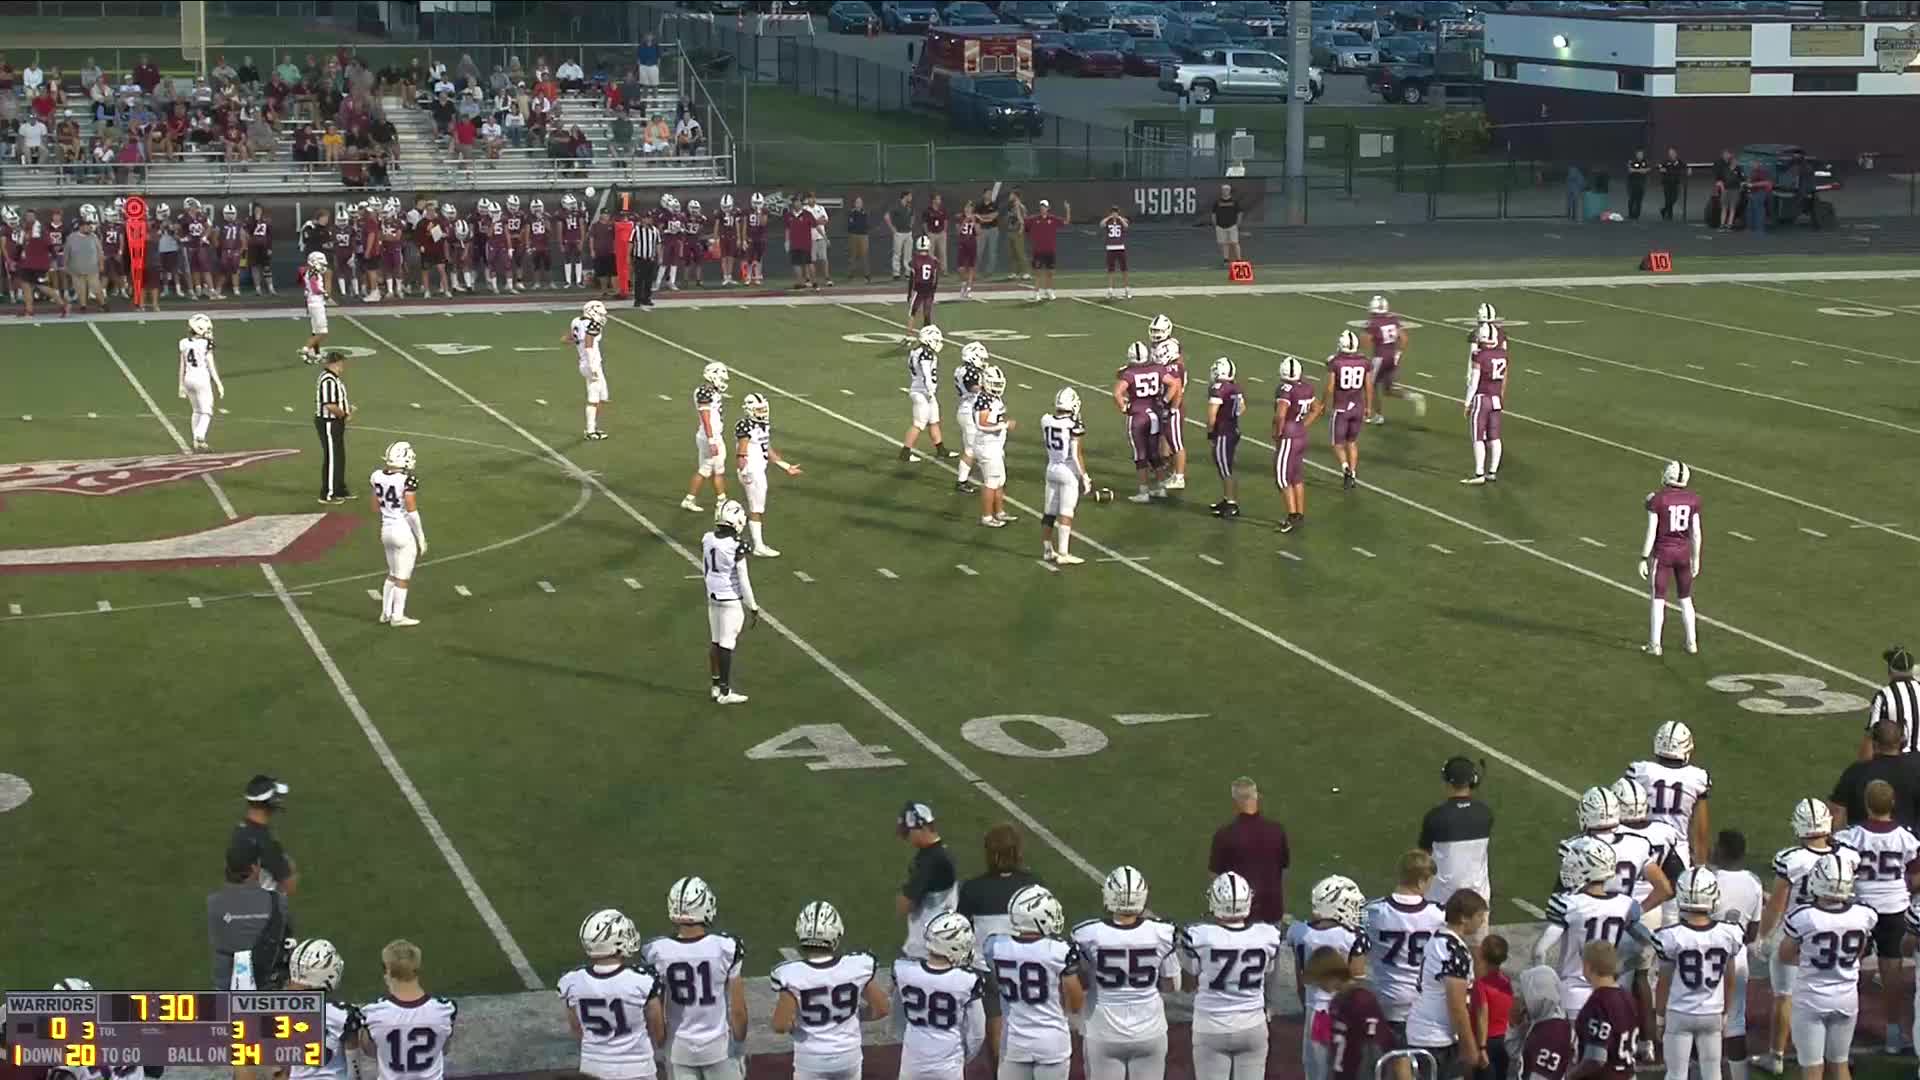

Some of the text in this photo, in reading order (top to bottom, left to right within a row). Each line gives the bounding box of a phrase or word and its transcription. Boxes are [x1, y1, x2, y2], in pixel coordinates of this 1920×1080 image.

[1135, 187, 1197, 215] 45036
[106, 231, 117, 243] 21
[224, 226, 237, 239] 71
[1108, 225, 1121, 237] 36
[922, 264, 931, 280] 6
[1234, 265, 1250, 279] 20
[1654, 255, 1668, 271] 10
[186, 349, 198, 367] 4
[1492, 358, 1507, 380] 12
[1134, 371, 1160, 398] 53
[1340, 366, 1366, 390] 88
[1044, 426, 1064, 451] 15
[374, 485, 401, 509] 24
[1668, 504, 1691, 533] 18
[1706, 673, 1871, 715] 3
[1652, 779, 1684, 815] 11
[1857, 849, 1904, 881] 65
[1584, 916, 1625, 948] 10
[1811, 929, 1867, 970] 39
[997, 959, 1049, 1005] 58
[1096, 948, 1158, 990] 55
[1209, 948, 1267, 992] 72
[1679, 947, 1730, 990] 83
[666, 961, 717, 1007] 81
[579, 997, 632, 1038] 51
[800, 983, 860, 1027] 59
[903, 984, 958, 1031] 28
[1588, 1018, 1612, 1040] 58
[386, 1027, 438, 1073] 12
[1536, 1047, 1561, 1071] 23
